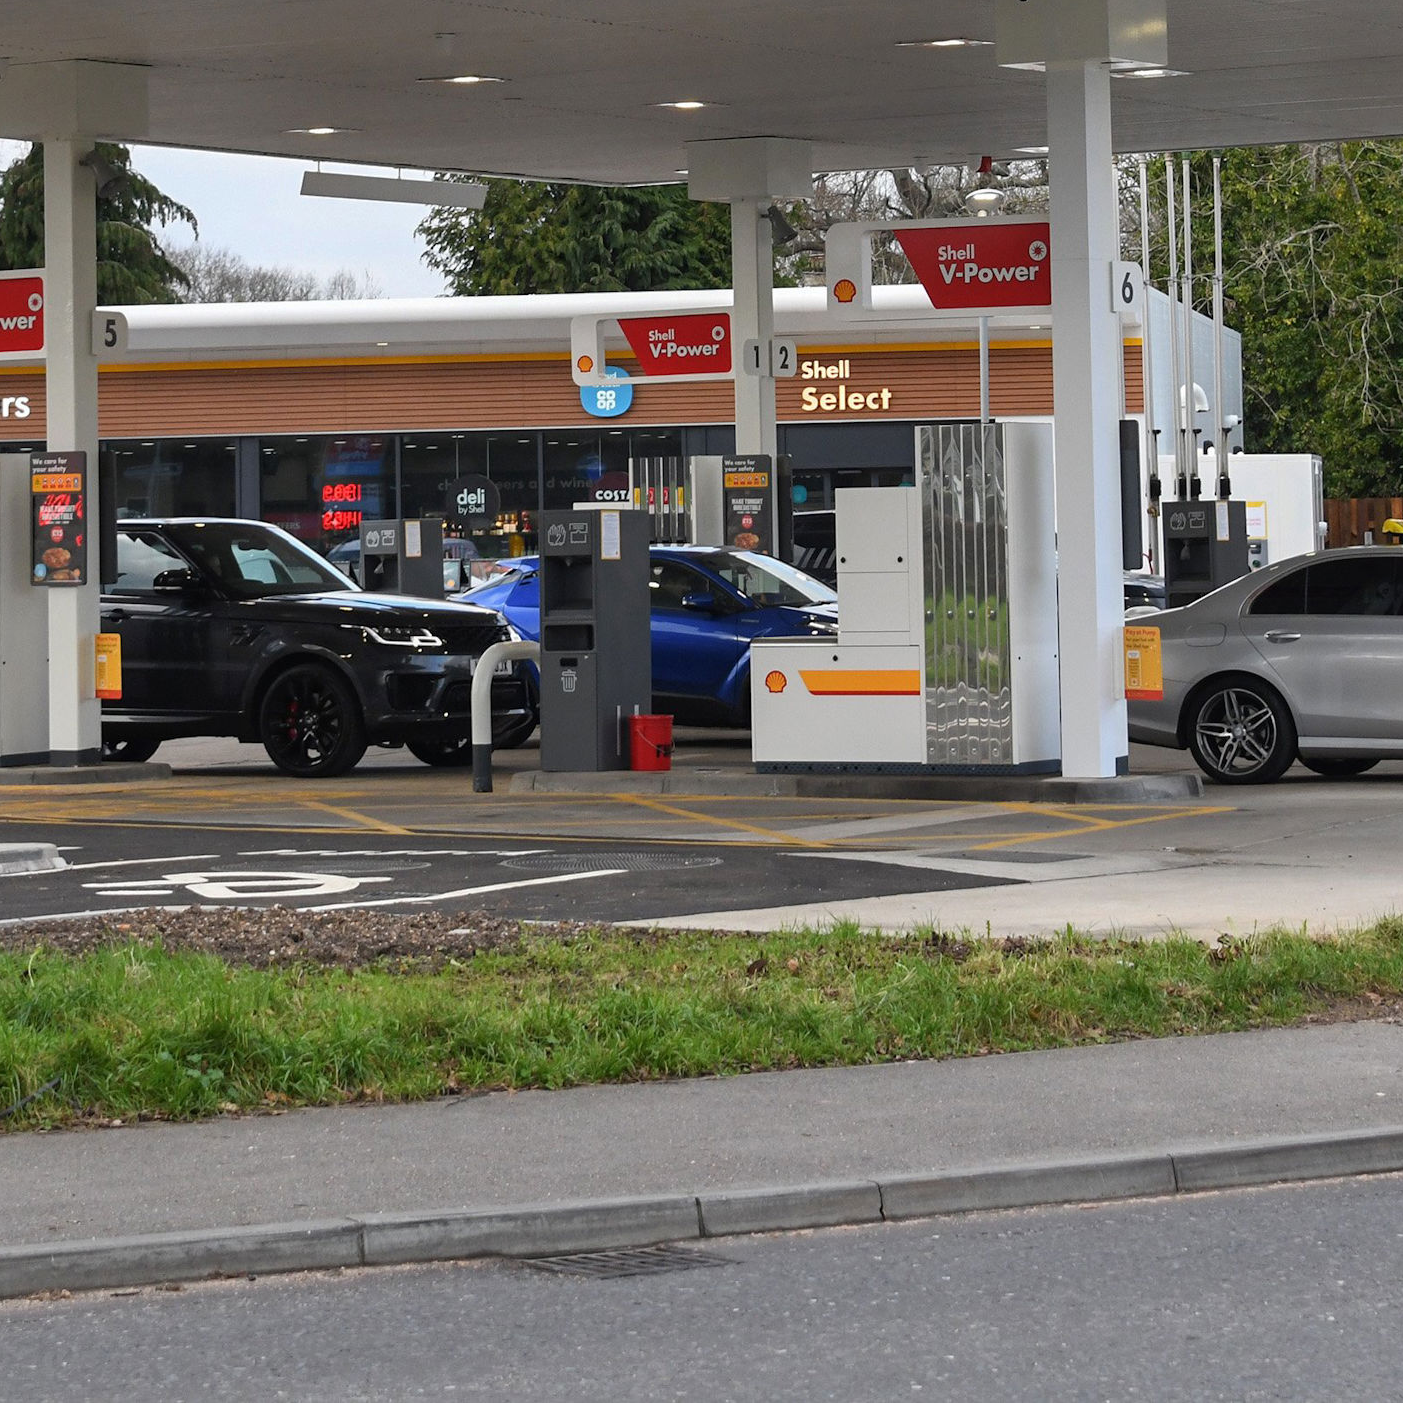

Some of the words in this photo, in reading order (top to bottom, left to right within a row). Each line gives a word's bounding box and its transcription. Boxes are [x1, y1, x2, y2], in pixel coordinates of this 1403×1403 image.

[938, 244, 975, 261] Shell
[939, 263, 1039, 284] V-Power
[1121, 272, 1133, 304] 6
[105, 319, 117, 347] 5
[648, 328, 675, 341] Shell
[649, 342, 719, 358] V-Power
[754, 346, 760, 368] 1
[779, 346, 788, 369] 2
[801, 359, 850, 379] Shell
[801, 385, 891, 412] Select
[48, 466, 67, 474] safety
[498, 479, 524, 490] eers
[529, 477, 555, 489] ad
[456, 488, 486, 505] deli
[458, 505, 468, 515] by
[468, 504, 485, 514] Shell
